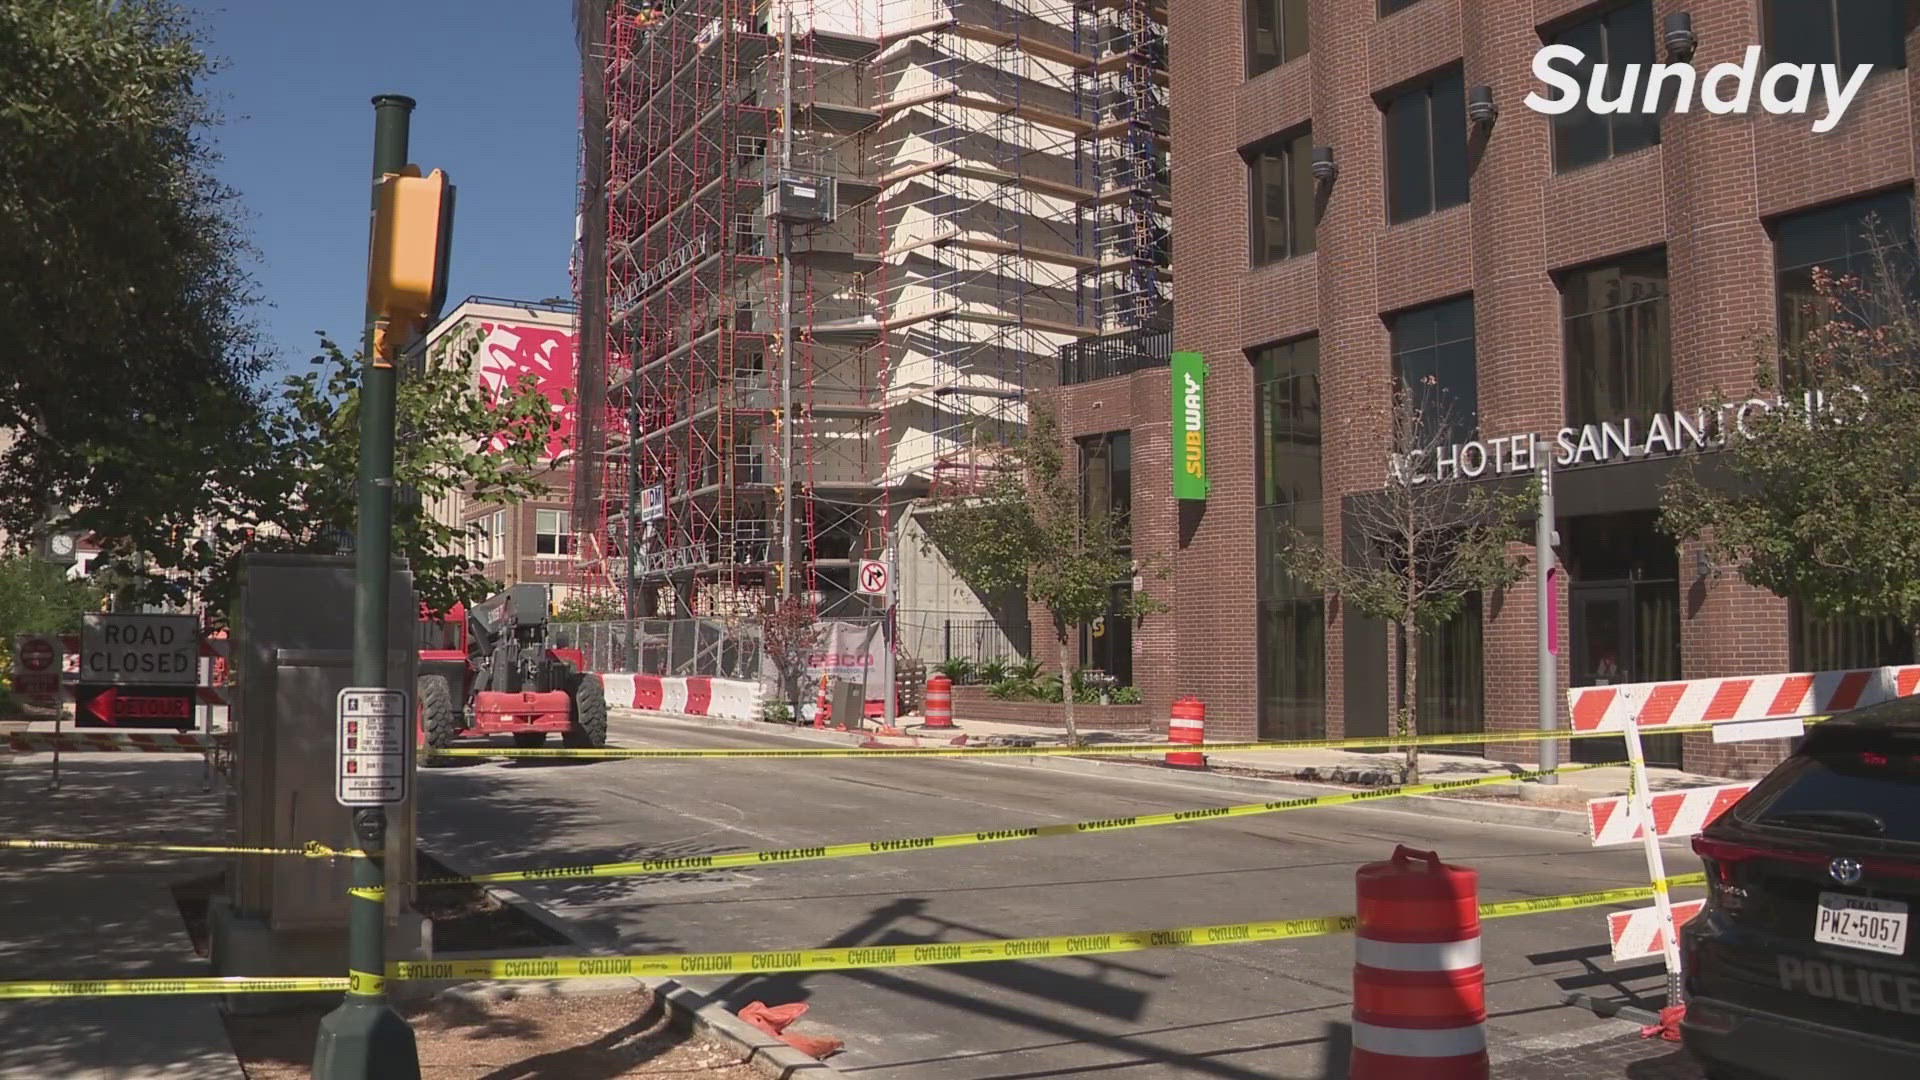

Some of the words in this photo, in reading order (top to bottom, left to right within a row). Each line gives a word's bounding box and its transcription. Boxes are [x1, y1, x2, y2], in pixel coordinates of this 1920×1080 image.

[1183, 371, 1203, 480] SUBWAY
[1437, 432, 1536, 481] HOTEL
[1557, 416, 1631, 466] SAN
[534, 561, 561, 576] BILL
[105, 625, 175, 645] ROAD
[89, 652, 189, 674] CLOSED
[115, 699, 183, 715] DETOUR
[1845, 898, 1879, 911] TEXAS
[1858, 916, 1901, 943] 5057
[1776, 954, 1920, 1014] POLICE
